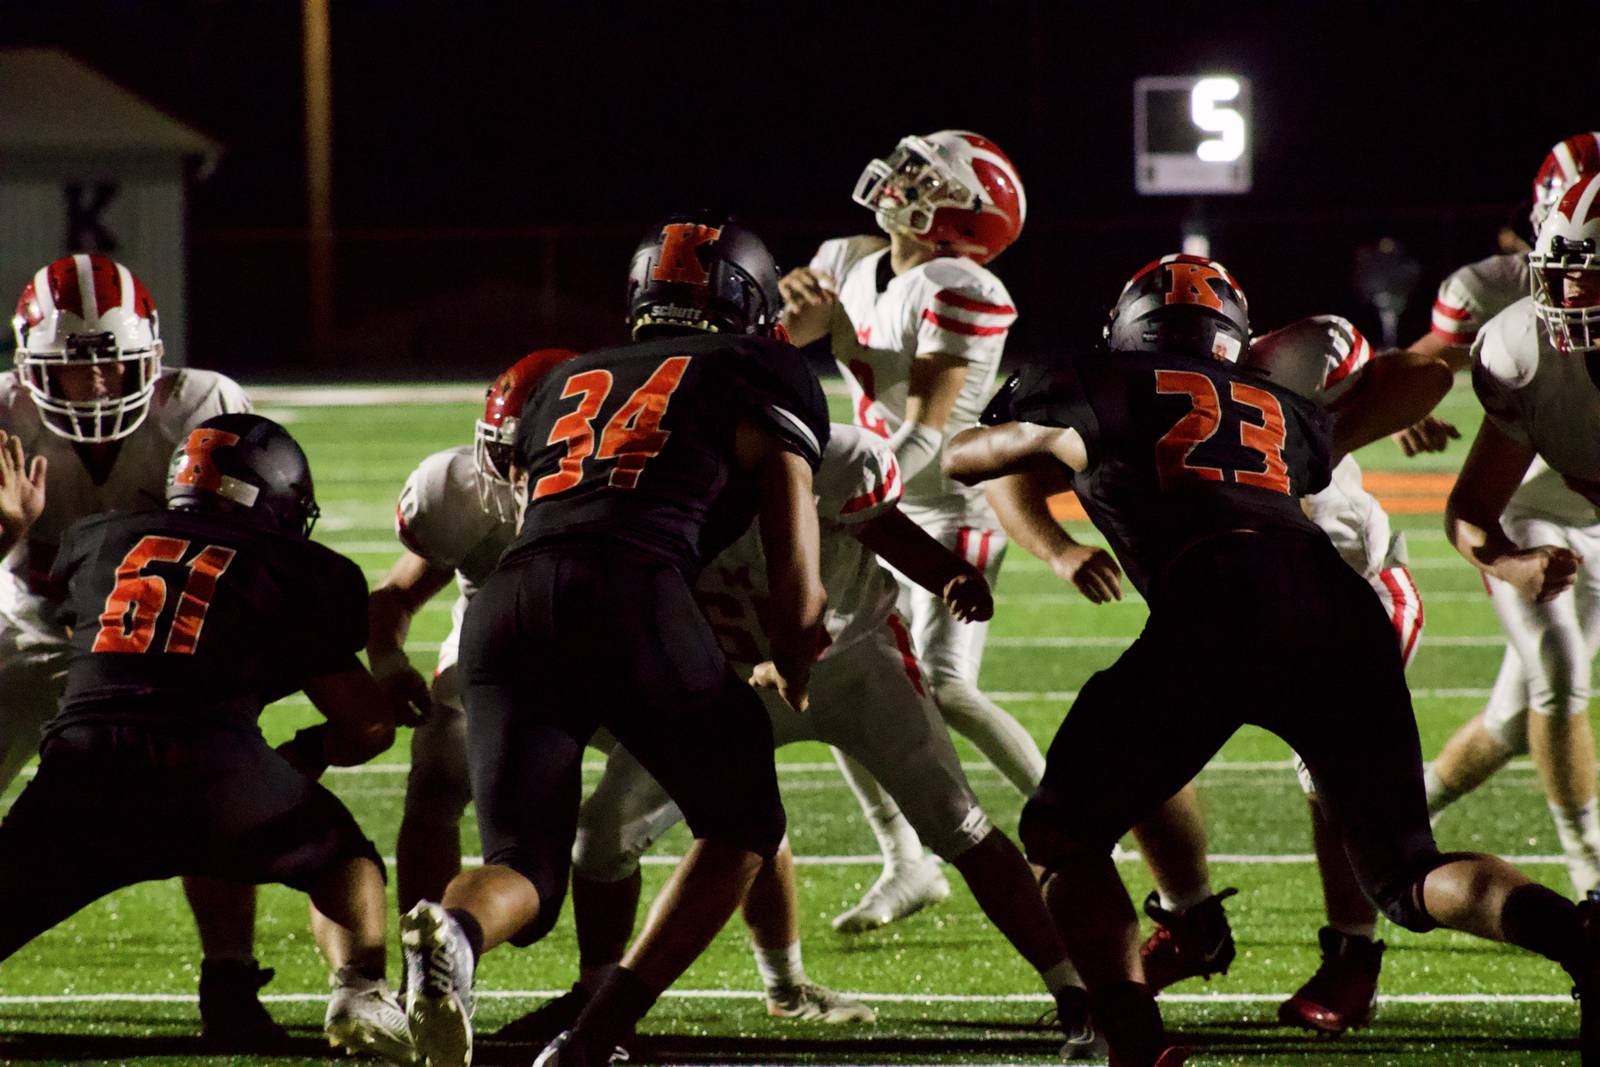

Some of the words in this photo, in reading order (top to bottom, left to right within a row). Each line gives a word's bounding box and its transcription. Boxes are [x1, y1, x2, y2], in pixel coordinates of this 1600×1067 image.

[1190, 78, 1245, 162] 5
[63, 184, 115, 252] K
[653, 222, 725, 287] K
[1165, 262, 1224, 311] K
[531, 356, 693, 502] 34
[1154, 369, 1291, 496] 23
[91, 535, 238, 656] 61
